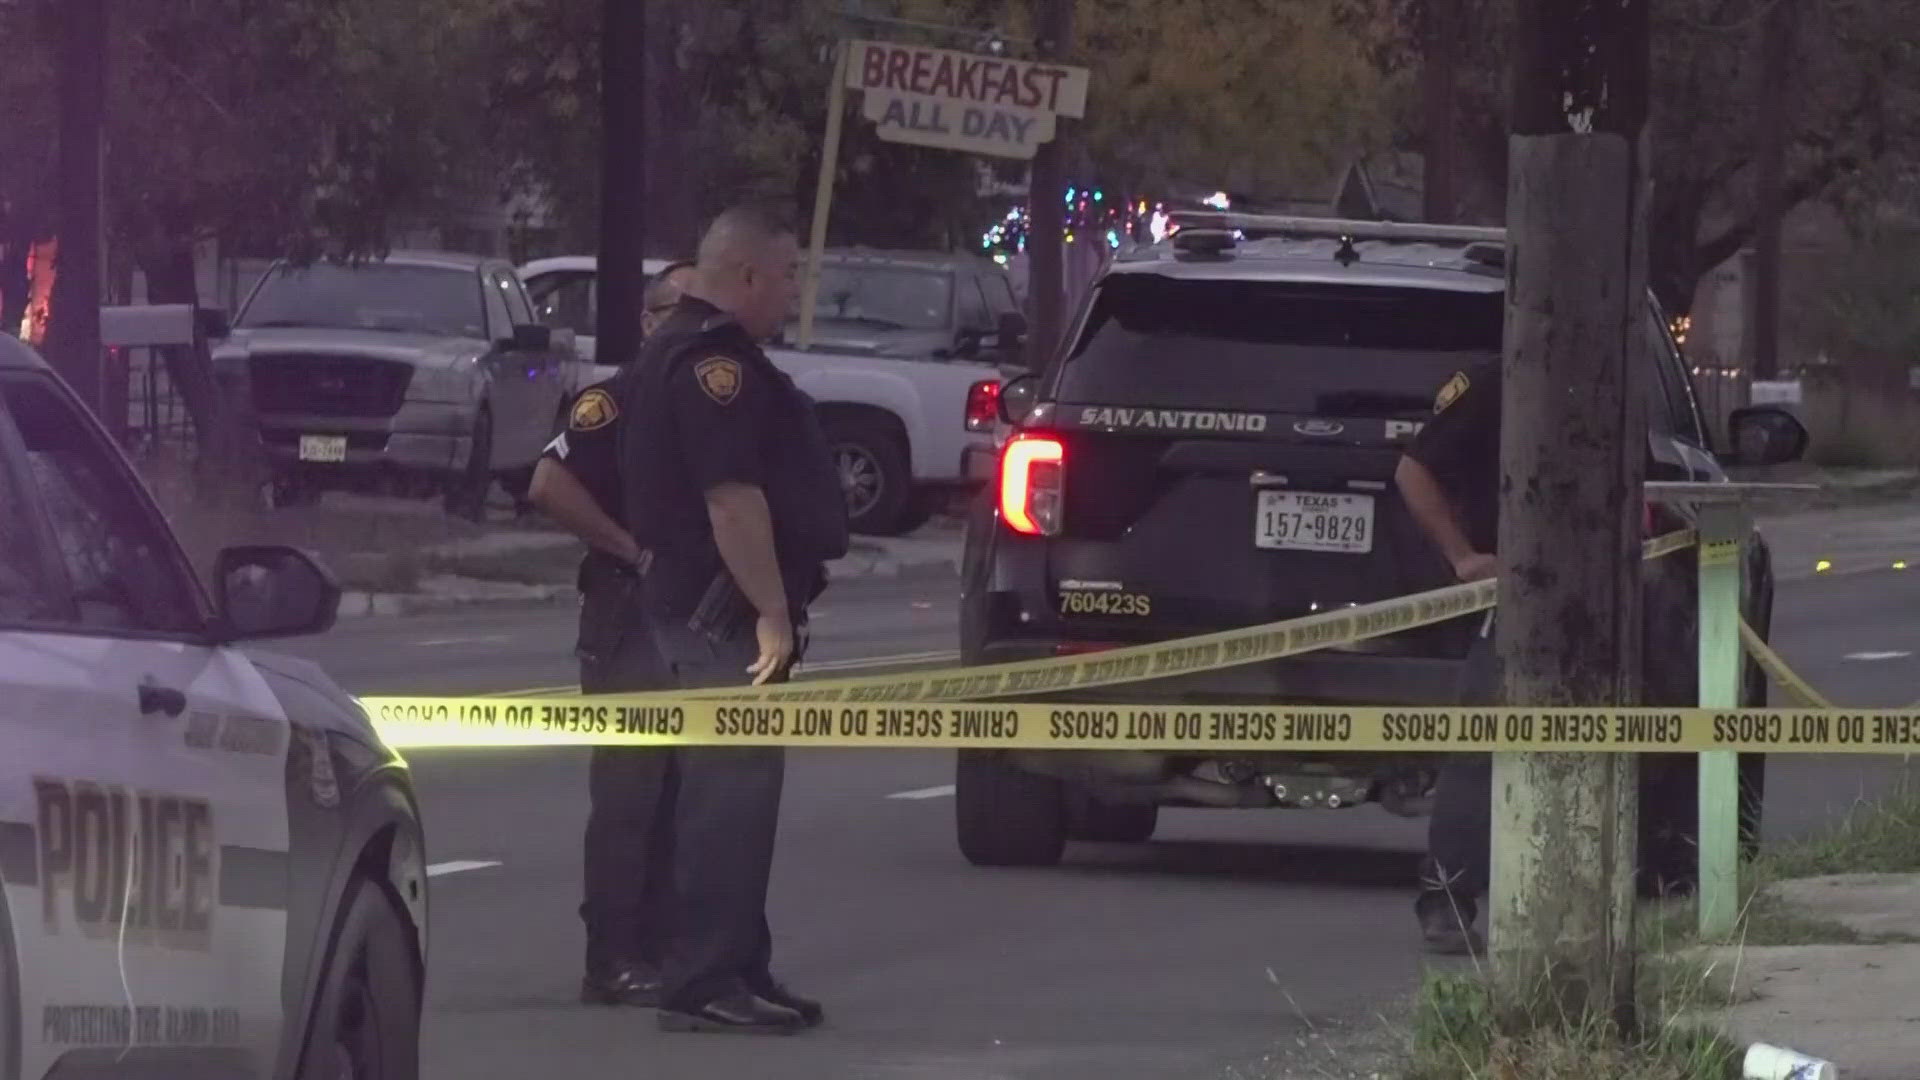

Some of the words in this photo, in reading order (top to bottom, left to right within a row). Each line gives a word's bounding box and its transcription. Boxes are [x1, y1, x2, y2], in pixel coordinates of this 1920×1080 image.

[863, 46, 1068, 112] BREAKFAST
[882, 98, 949, 134] ALL
[961, 109, 1035, 144] DAY
[1079, 408, 1135, 426] SAN
[1136, 410, 1267, 432] ANTONIO
[1295, 496, 1338, 507] TEXAS
[1059, 591, 1151, 616] 760423S
[541, 705, 607, 733] SCENE
[615, 706, 684, 735] CRIME
[715, 706, 785, 736] CROSS
[790, 707, 832, 736] NOT
[840, 708, 868, 736] DO
[876, 709, 943, 737] SCENE
[951, 709, 1018, 738] CRIME
[1050, 710, 1118, 739] CROSS
[1125, 711, 1167, 739] NOT
[1174, 711, 1201, 740] DO
[1209, 712, 1276, 741] SCENE
[1283, 713, 1352, 741] CRIME
[1382, 713, 1450, 741] CROSS
[1457, 714, 1498, 742] NOT
[1505, 714, 1533, 742] DO
[1541, 714, 1608, 742] SCENE
[1614, 714, 1682, 743] CRIME
[1713, 714, 1782, 743] CROSS
[1788, 715, 1830, 743] NOT
[1837, 715, 1864, 743] DO
[33, 775, 212, 950] POLICE
